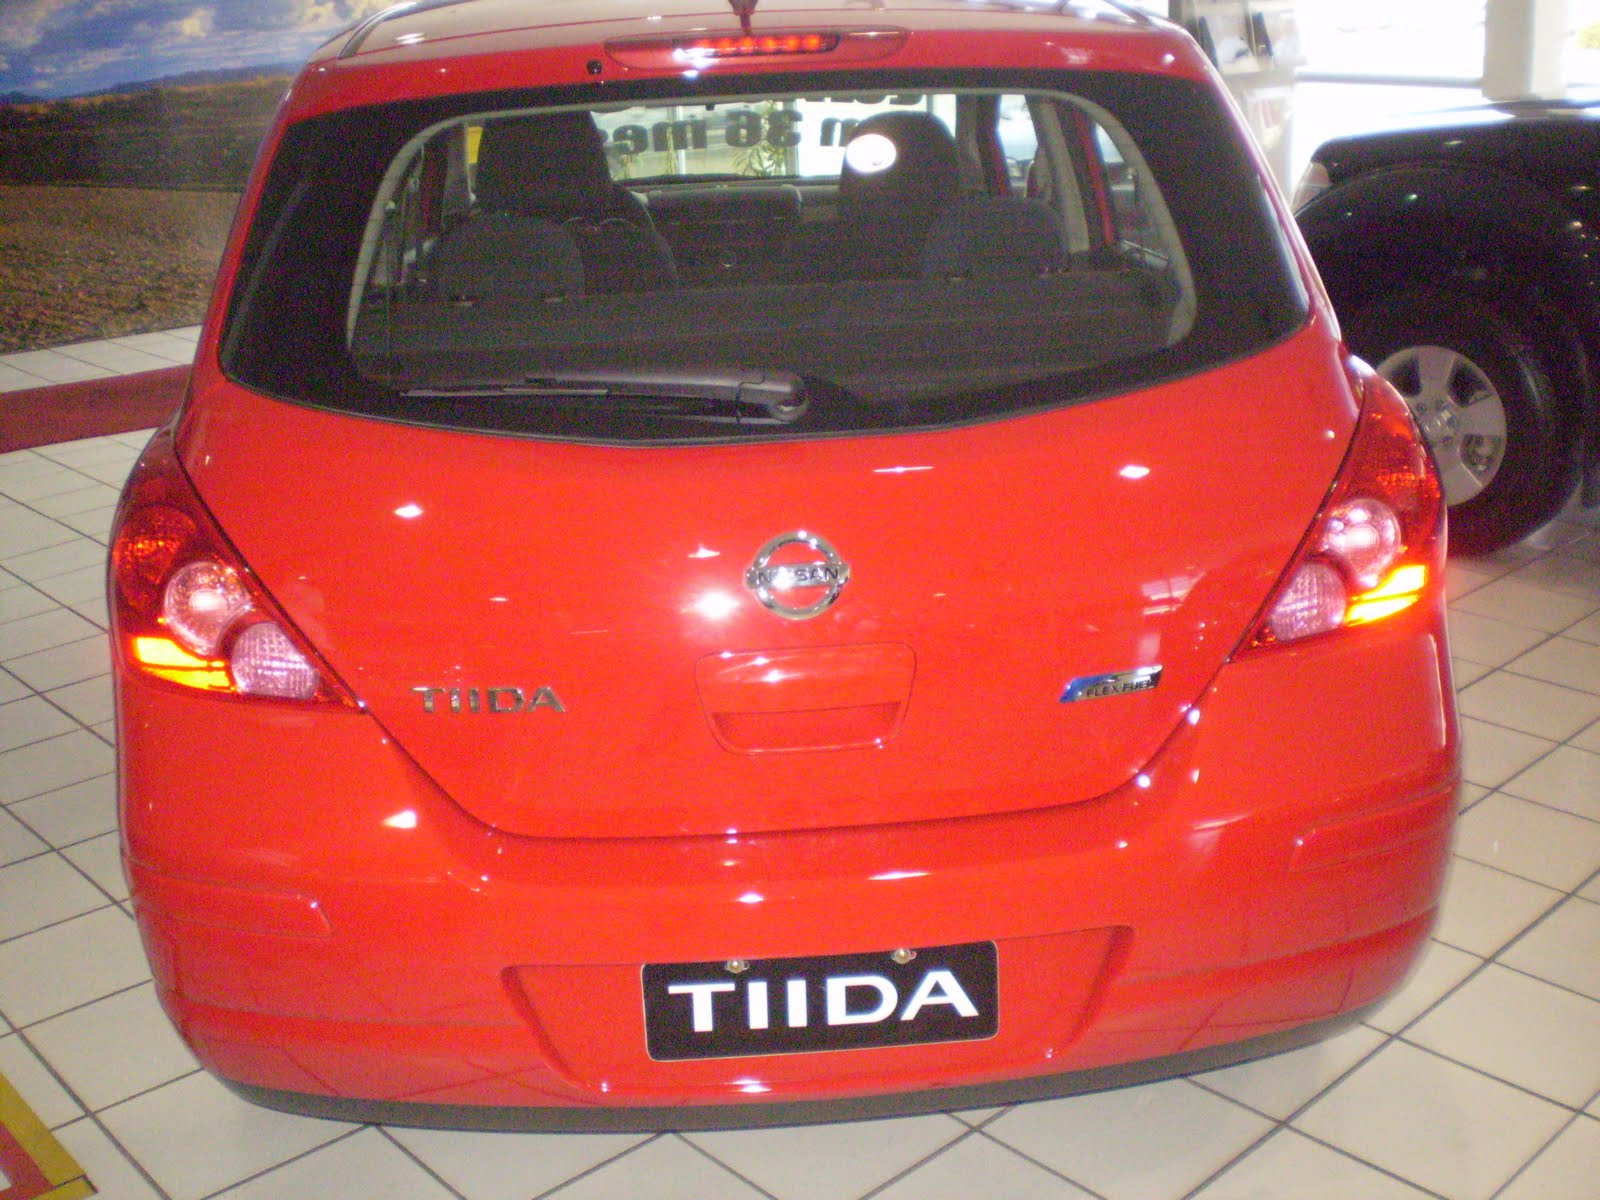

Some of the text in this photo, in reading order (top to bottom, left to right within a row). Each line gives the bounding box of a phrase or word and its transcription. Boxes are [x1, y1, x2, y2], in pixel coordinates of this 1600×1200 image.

[758, 566, 839, 584] NSAN
[410, 686, 567, 713] TIIDA
[1086, 683, 1120, 697] FLEX
[667, 968, 980, 1033] TIIDA
